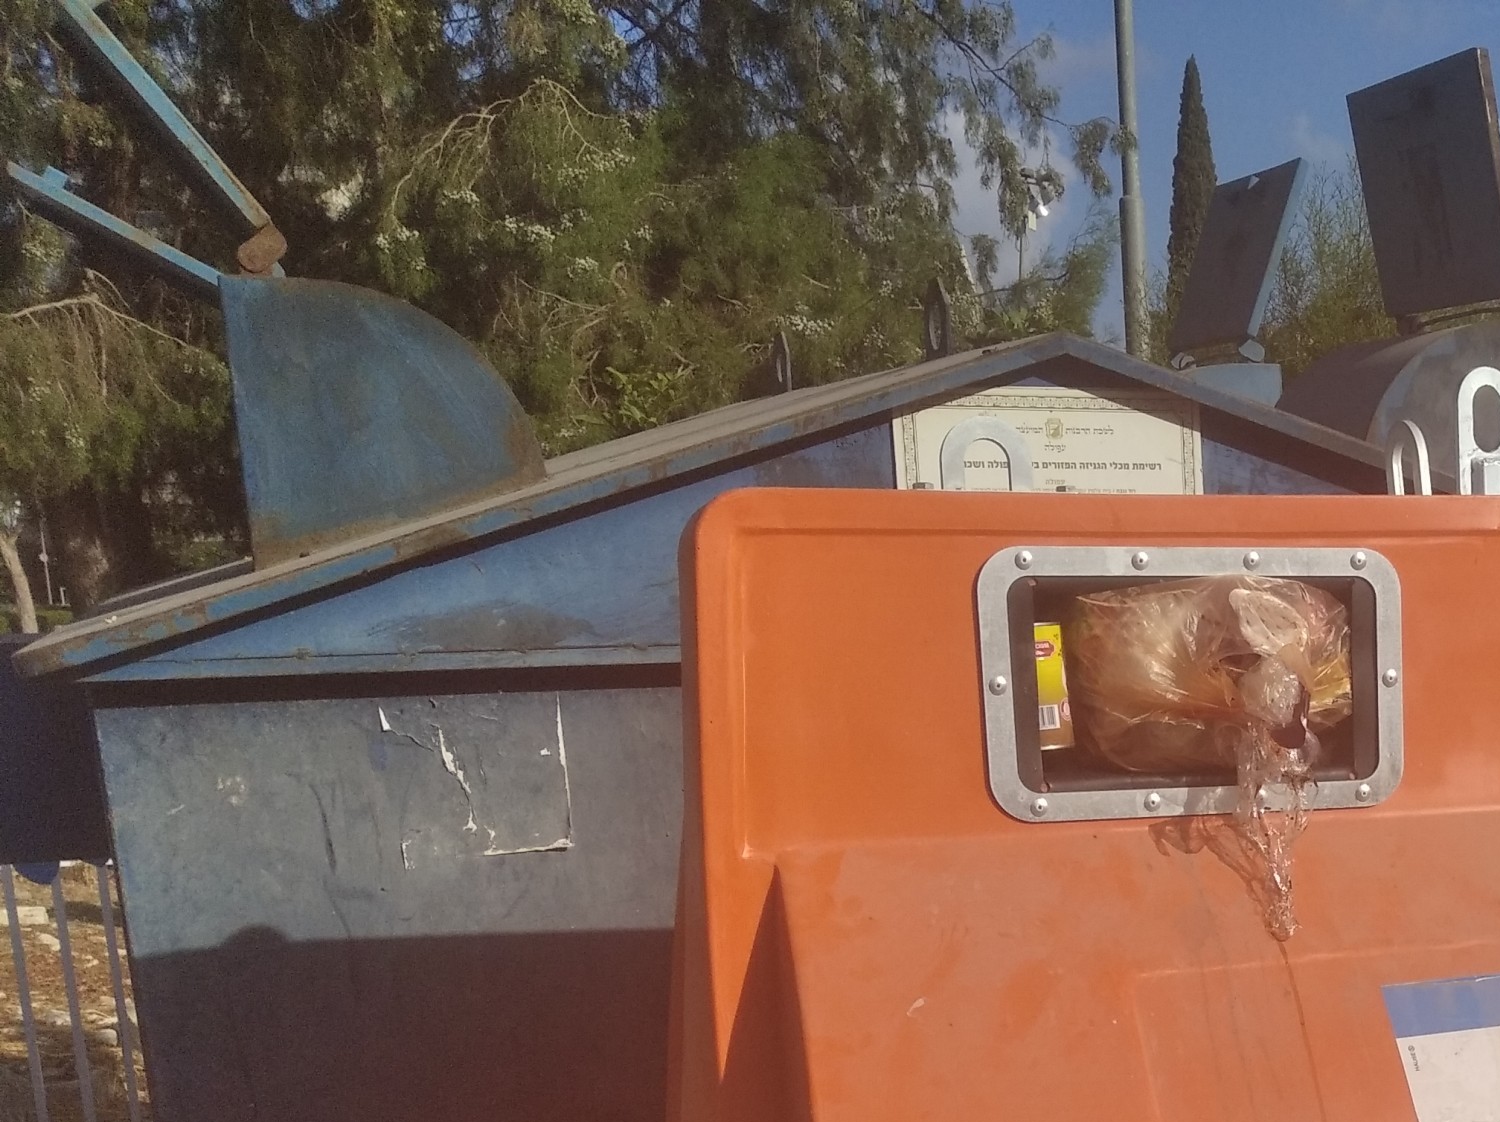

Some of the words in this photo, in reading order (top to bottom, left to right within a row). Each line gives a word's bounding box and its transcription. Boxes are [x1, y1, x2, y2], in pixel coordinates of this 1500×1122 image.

[1041, 461, 1077, 470] הפזורים
[1079, 461, 1107, 470] הגניזה
[1109, 460, 1130, 471] מכלי
[1131, 462, 1162, 471] רשימת
